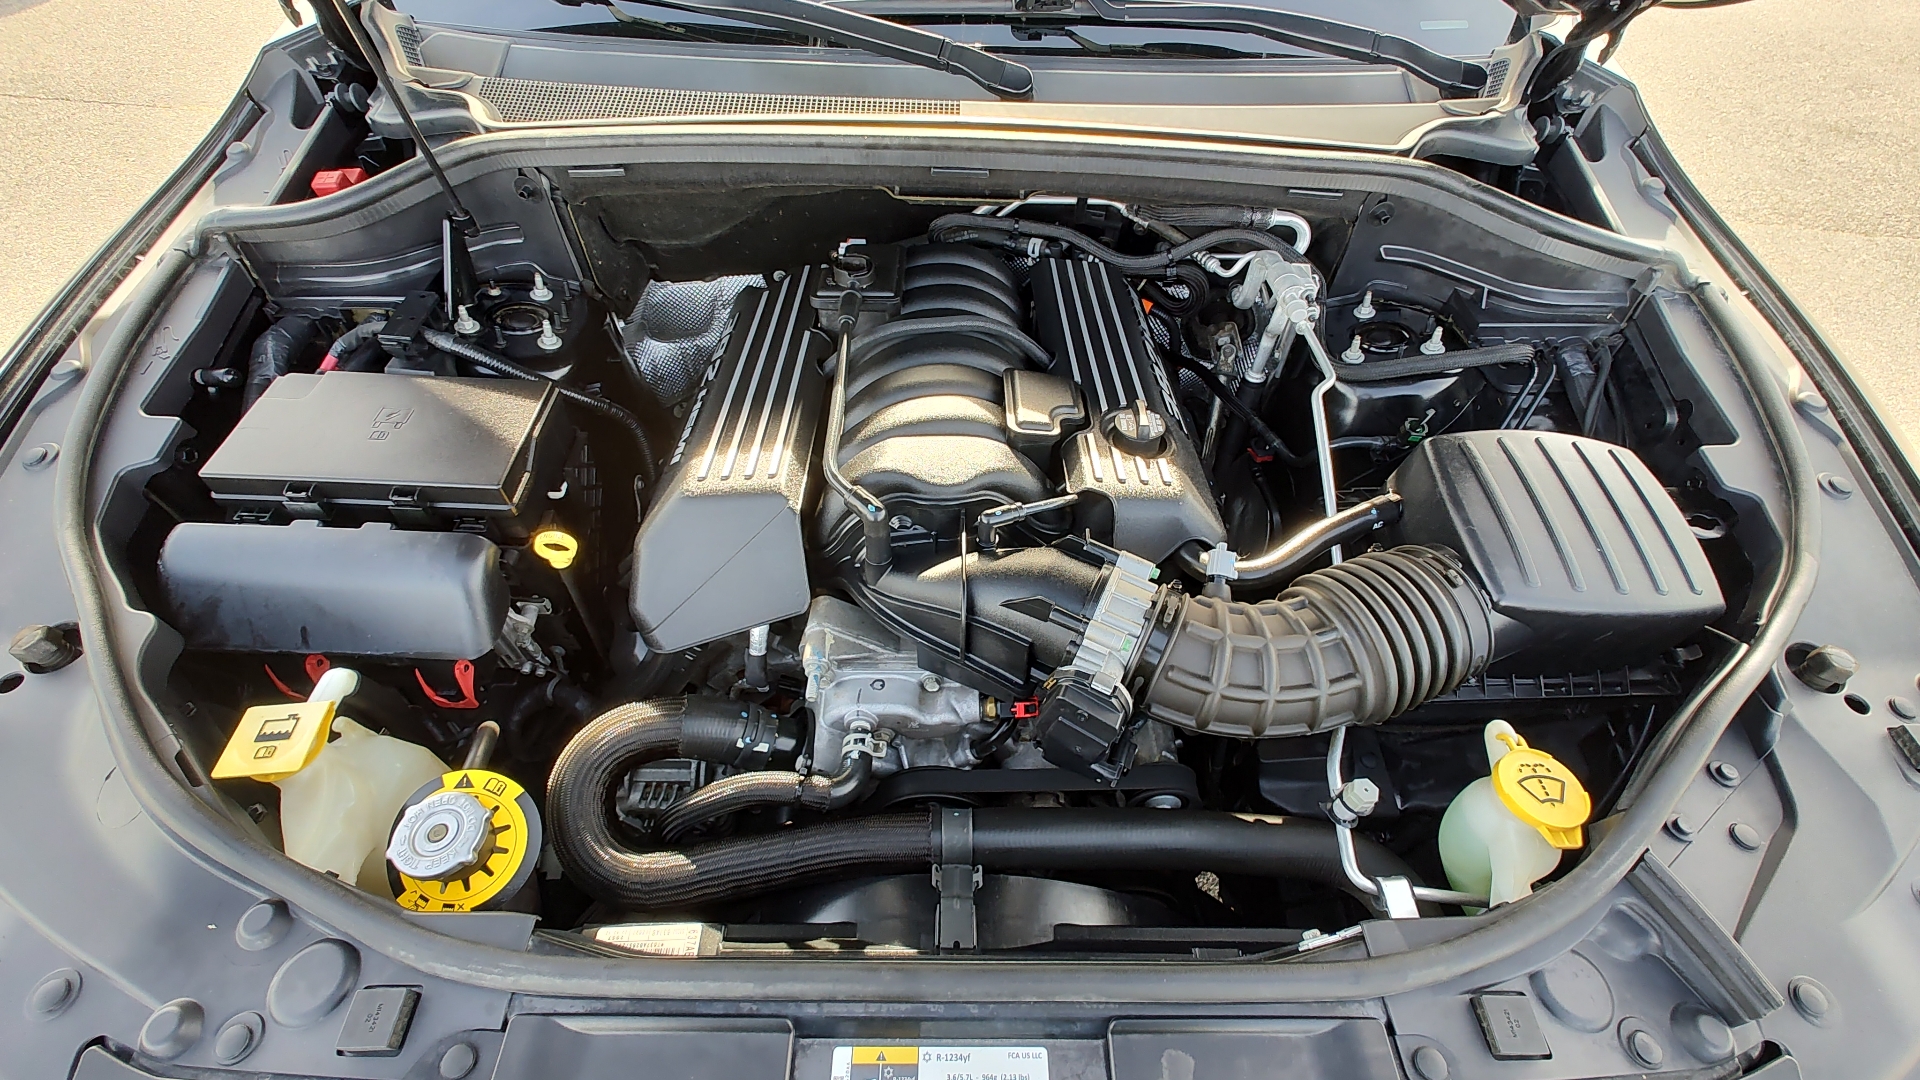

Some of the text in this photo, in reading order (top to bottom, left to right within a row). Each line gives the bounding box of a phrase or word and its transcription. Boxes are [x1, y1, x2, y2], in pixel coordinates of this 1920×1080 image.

[669, 311, 740, 466] 392 HEMI
[427, 796, 456, 810] OPEN
[396, 848, 457, 870] KEEP TIGHT
[936, 1053, 971, 1063] R-1234yf
[1007, 1051, 1043, 1059] FCA US LLC
